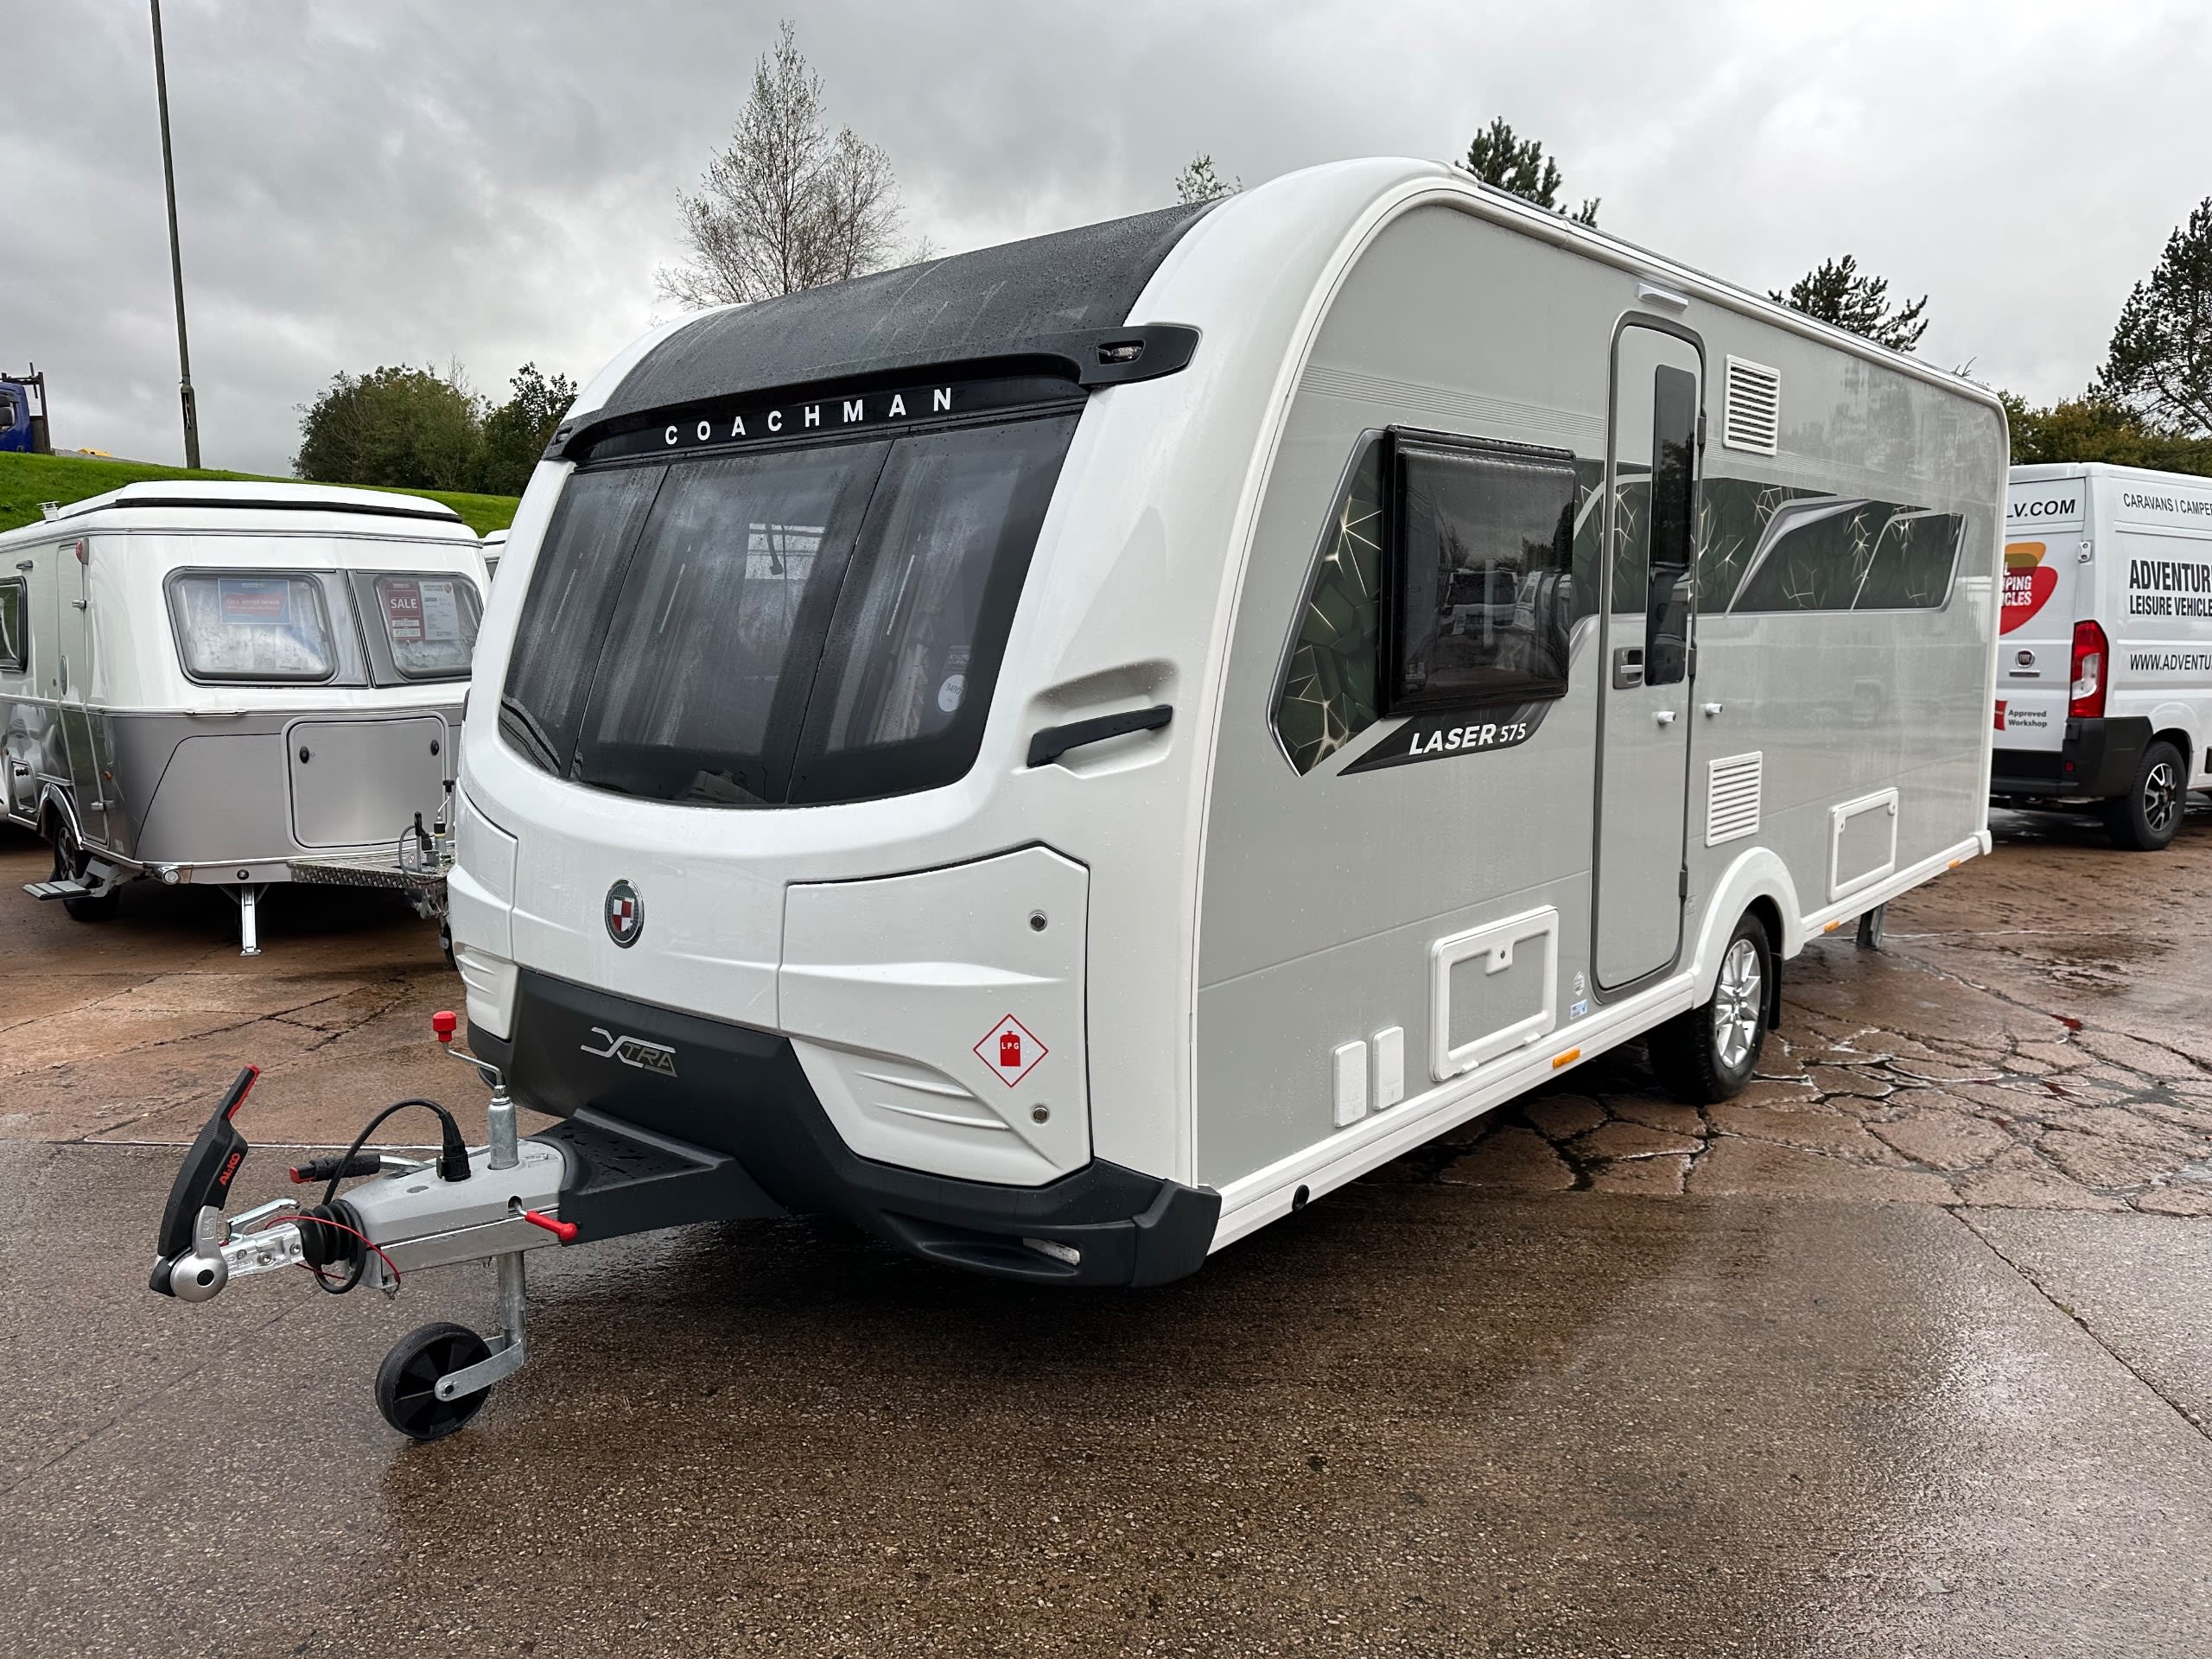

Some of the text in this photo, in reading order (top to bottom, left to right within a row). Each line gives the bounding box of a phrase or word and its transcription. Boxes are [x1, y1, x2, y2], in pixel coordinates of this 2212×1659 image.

[664, 387, 951, 445] COACHMAN
[2123, 493, 2174, 512] CARAVANS
[2003, 575, 2032, 591] PING
[2129, 559, 2212, 594] ADVENTUR
[390, 598, 418, 609] SALE
[2002, 591, 2032, 607] CLES
[2130, 594, 2172, 616] LEISURE
[2130, 653, 2212, 671] WWW.ADVENTU
[2008, 709, 2047, 718] Approved
[2008, 719, 2048, 728] Workshop
[1408, 722, 1527, 756] LASER 575
[219, 1152, 241, 1186] AL-KO
